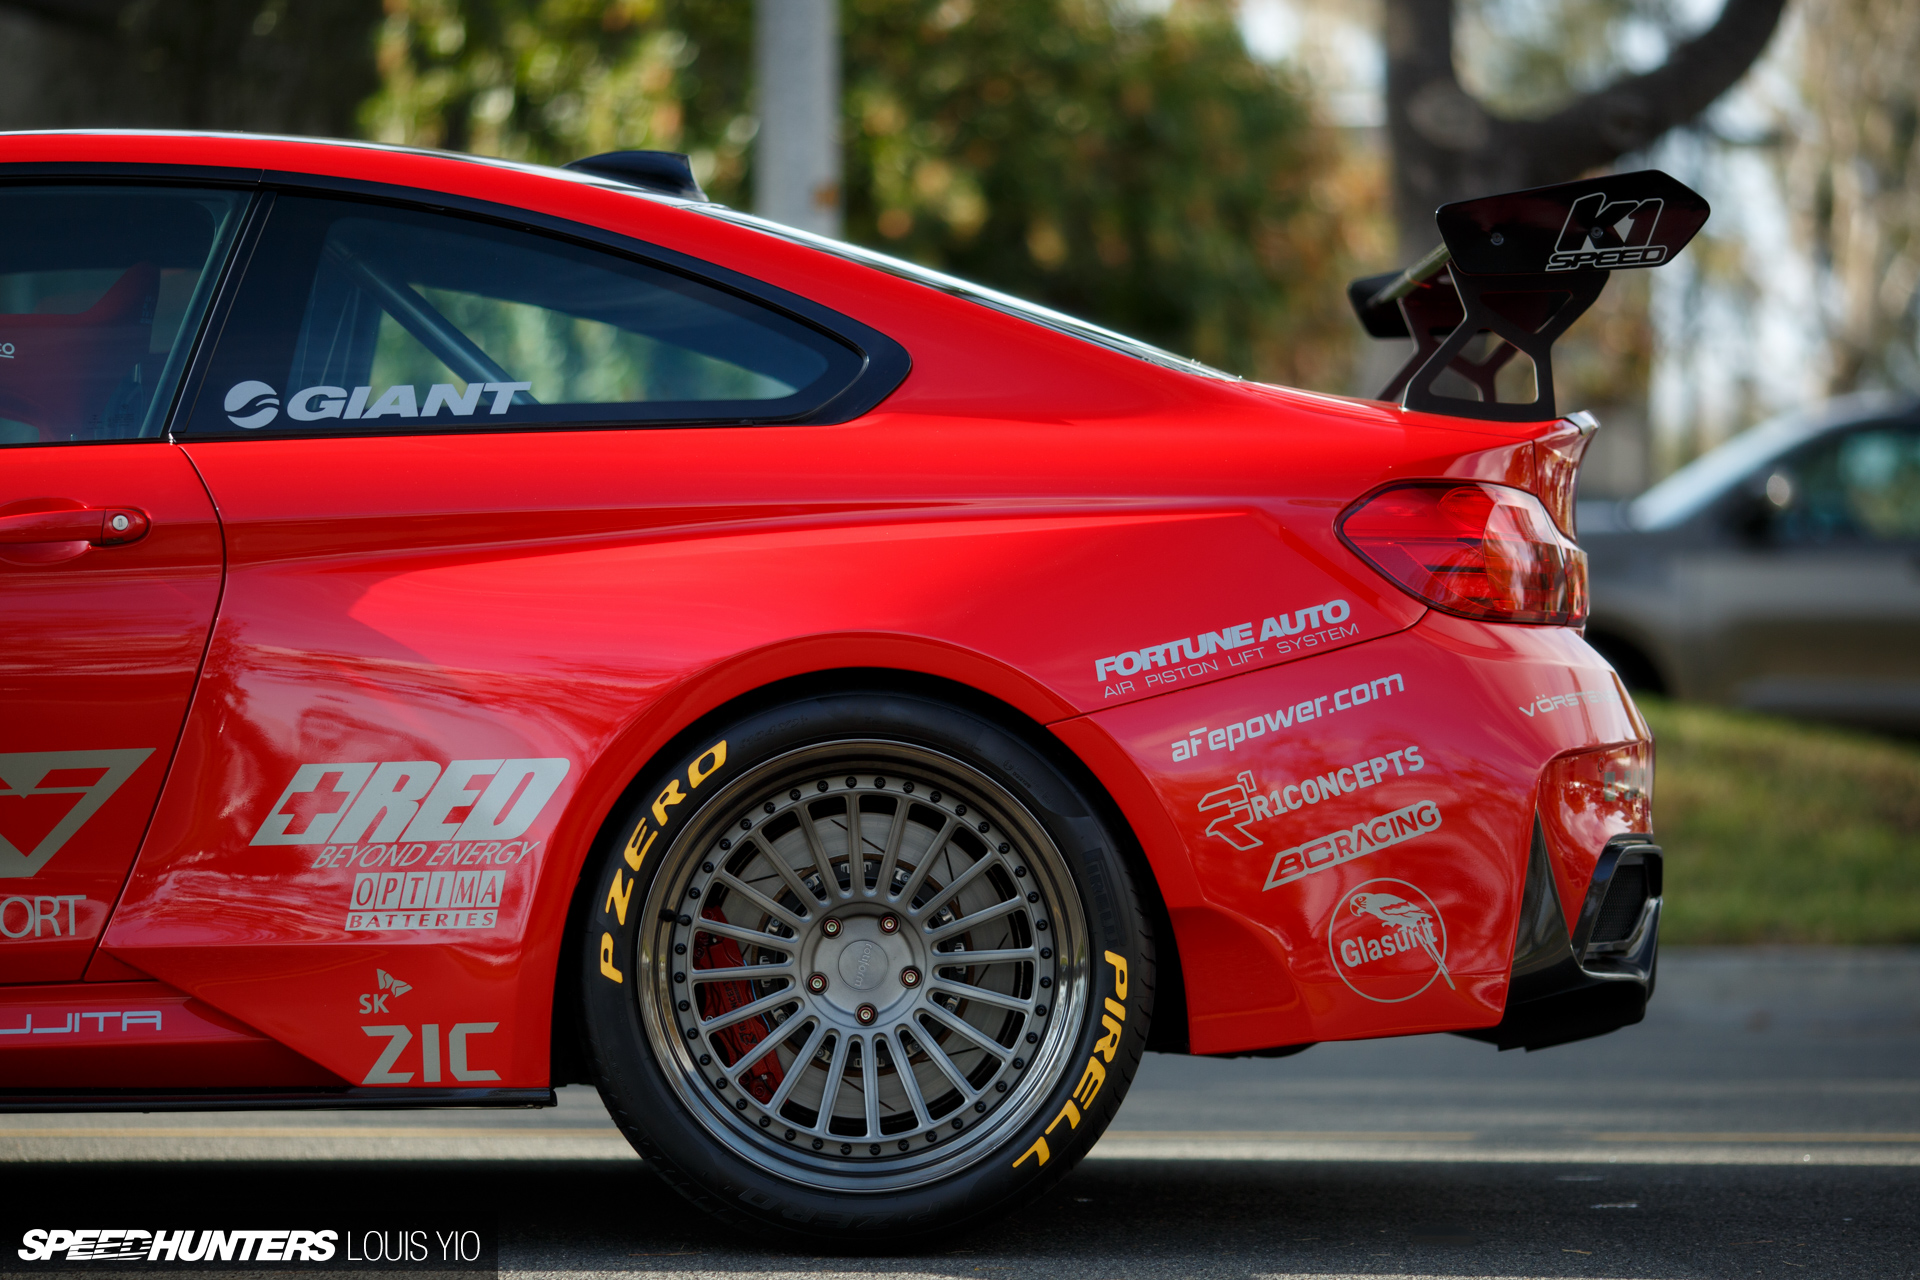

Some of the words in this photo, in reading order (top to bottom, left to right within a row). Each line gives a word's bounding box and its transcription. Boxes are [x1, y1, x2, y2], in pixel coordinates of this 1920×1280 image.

[1554, 192, 1664, 253] K1
[1545, 245, 1667, 271] SPEED
[287, 381, 532, 421] GIANT
[1095, 622, 1255, 682] FORTUNE
[1260, 599, 1351, 642] AUTO
[1104, 681, 1136, 698] AIR
[1145, 660, 1219, 687] PISTON
[1228, 647, 1265, 667] LIFT
[1276, 623, 1360, 654] SYSTEM
[328, 758, 571, 844] RED
[1250, 745, 1425, 822] R1CONCEPTS
[311, 843, 428, 868] BEYOND
[426, 841, 542, 866] ENERGY
[353, 873, 500, 907] OPTIMA
[0, 894, 87, 938] ORT
[349, 911, 495, 929] BATTERIES
[1340, 917, 1438, 968] Glasurit
[359, 993, 389, 1014] SK
[361, 1022, 502, 1085] ZIC
